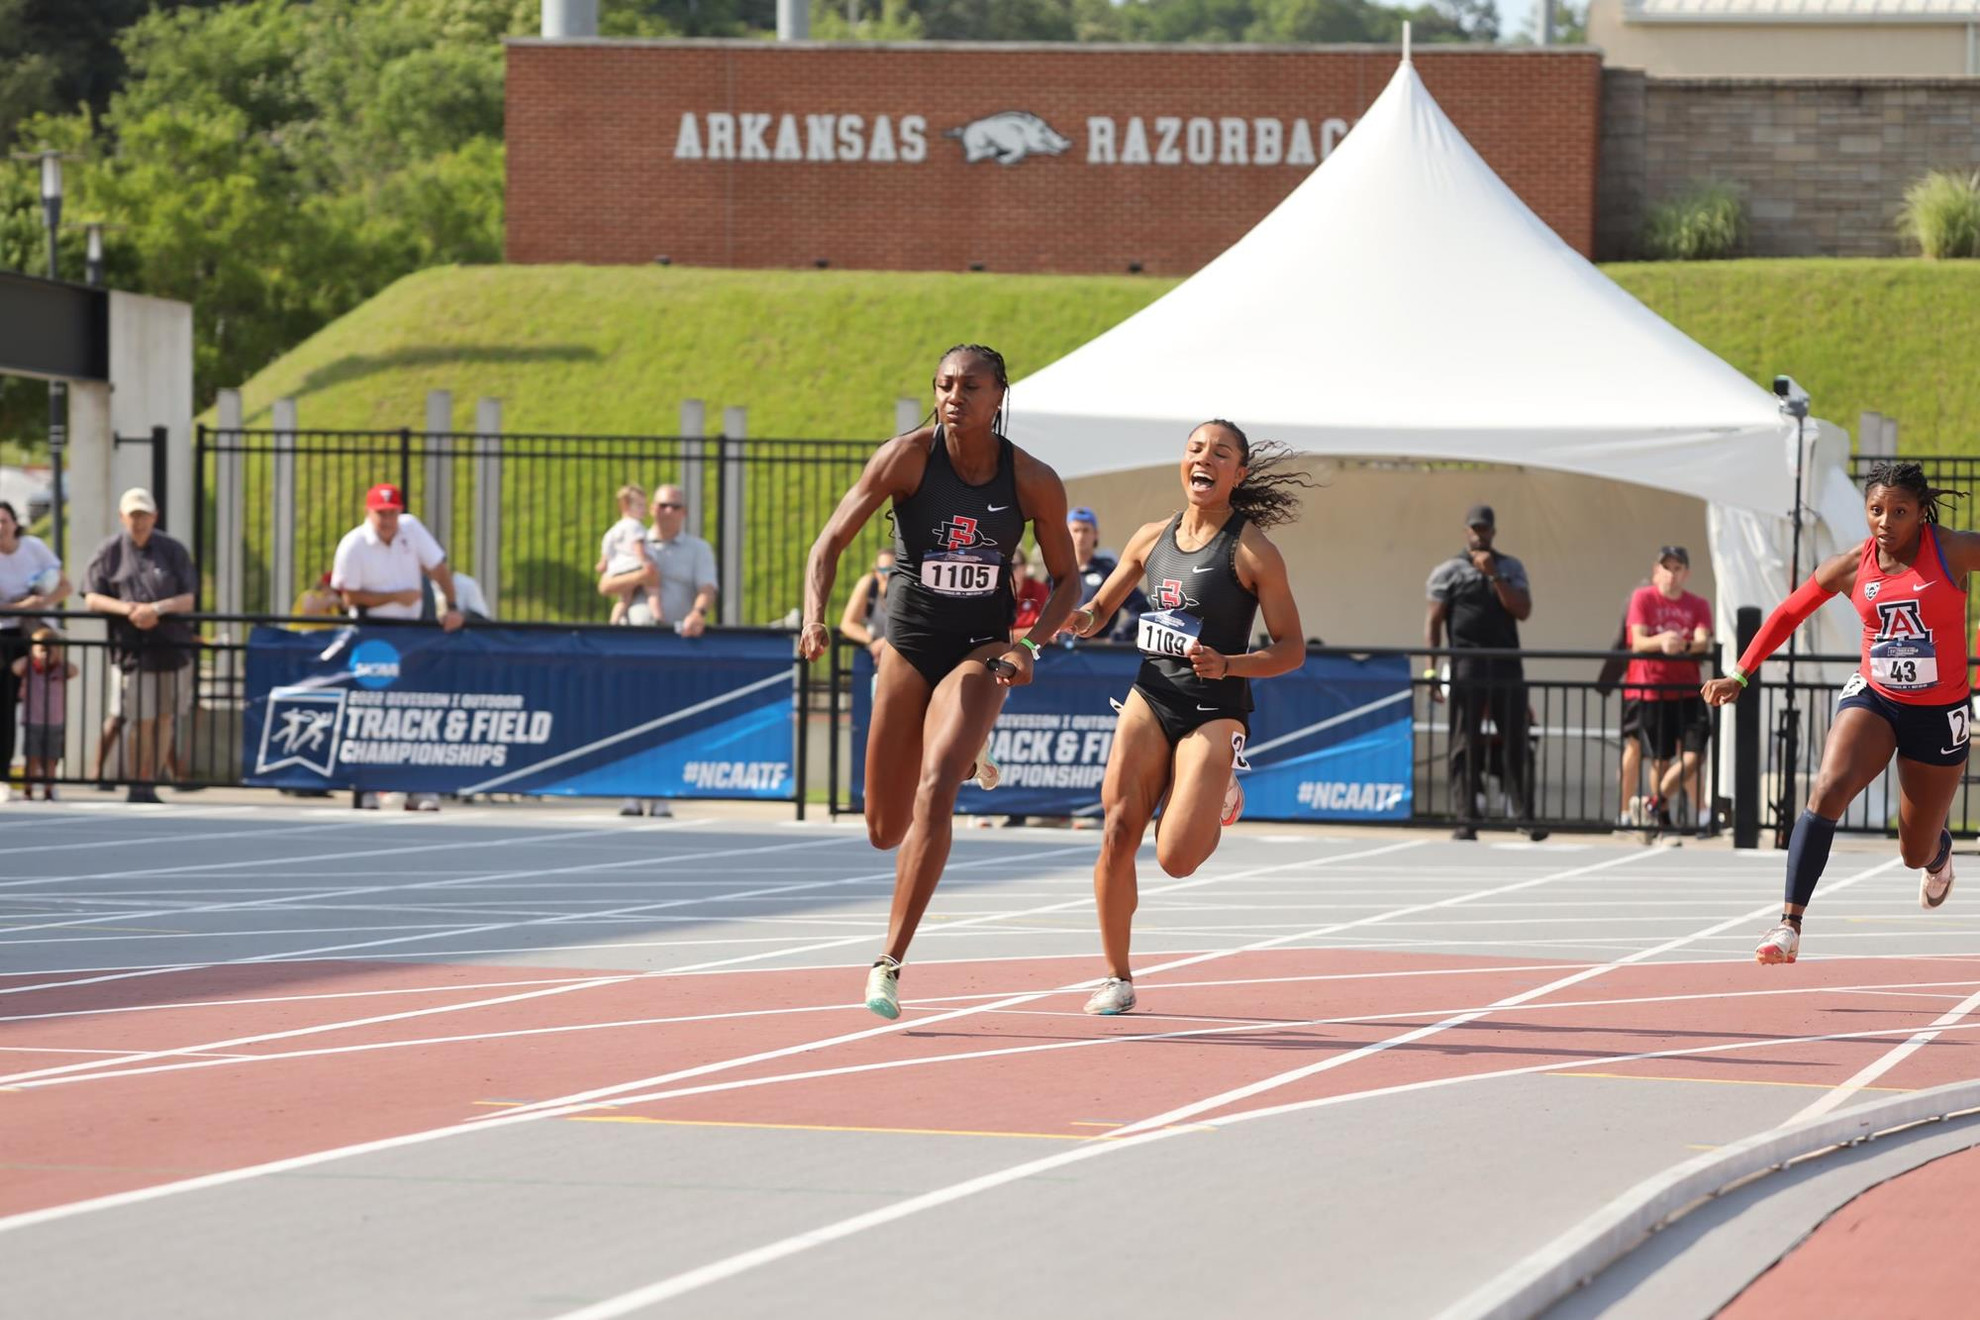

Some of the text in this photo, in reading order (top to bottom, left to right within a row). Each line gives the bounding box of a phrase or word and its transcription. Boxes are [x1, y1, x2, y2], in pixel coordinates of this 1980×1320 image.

[674, 112, 928, 163] ARKANSAS
[932, 564, 990, 589] 1105
[1146, 625, 1187, 656] 1109
[1890, 660, 1917, 683] 43
[386, 692, 450, 708] DIVISION
[461, 694, 524, 709] OUTDOOR
[346, 707, 553, 744] TRACK & FIELD
[1071, 714, 1118, 731] OUTDO
[1953, 709, 1967, 743] 2
[339, 741, 507, 766] CHAMPIONSHIPS
[986, 730, 1055, 763] ACK
[1056, 731, 1079, 763] &
[683, 761, 789, 790] #NCAATF
[1298, 781, 1405, 811] #NCAATF
